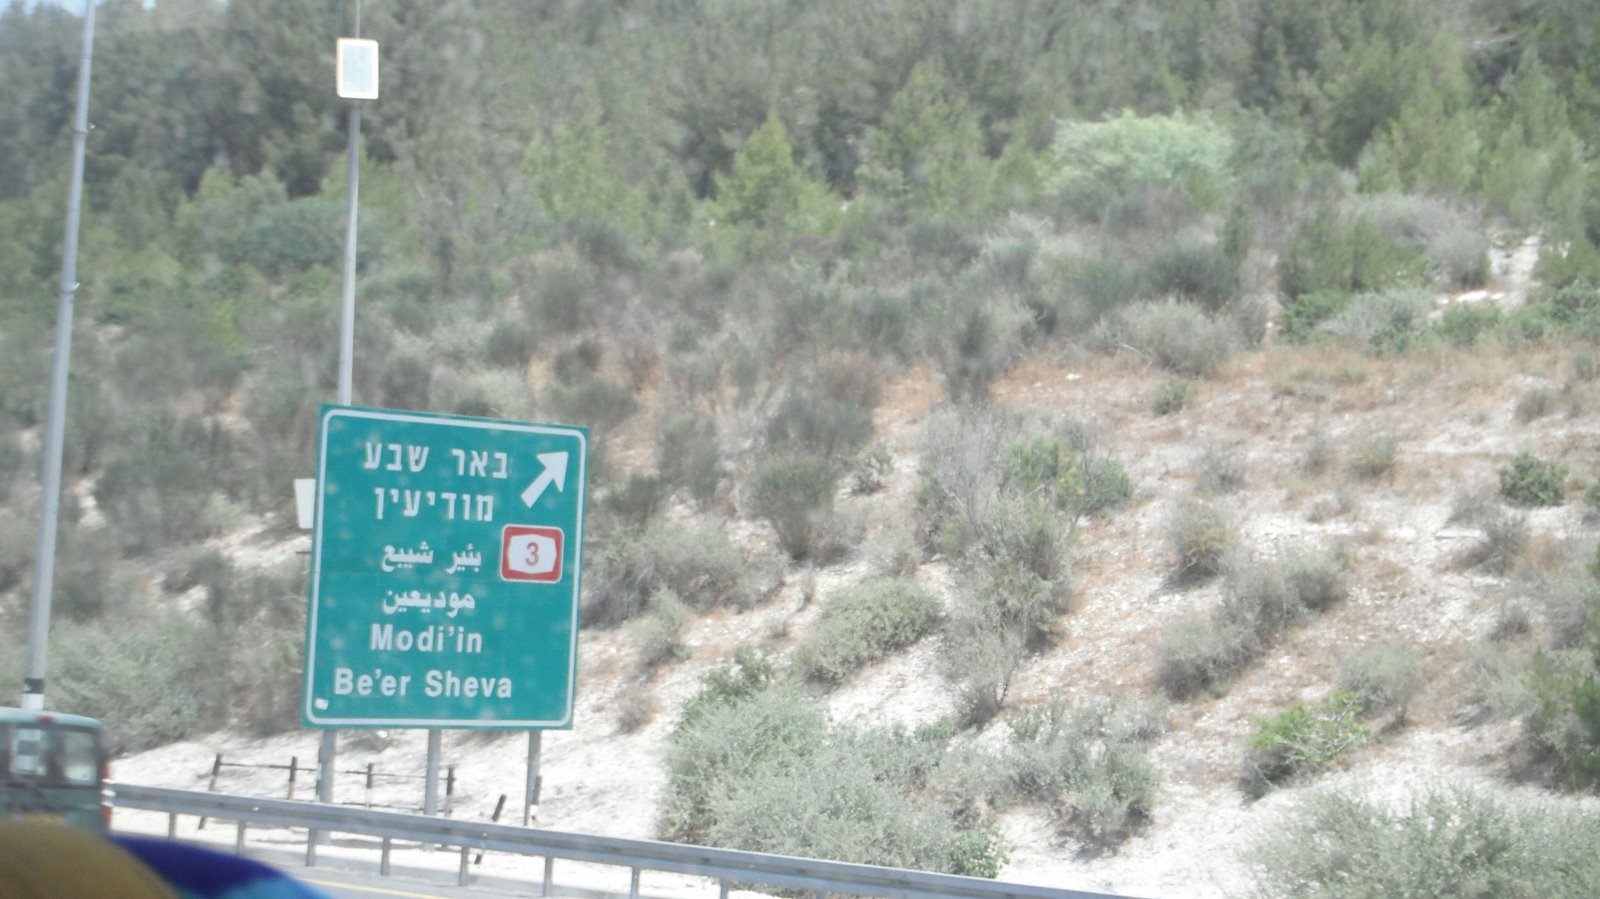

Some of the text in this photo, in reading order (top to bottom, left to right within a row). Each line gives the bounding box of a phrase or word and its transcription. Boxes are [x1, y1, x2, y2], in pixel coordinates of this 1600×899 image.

[363, 441, 508, 479] באר שבע
[373, 486, 494, 521] מודיעין
[525, 541, 540, 567] 3
[383, 589, 476, 617] موديعين
[424, 669, 513, 698] Sheva
